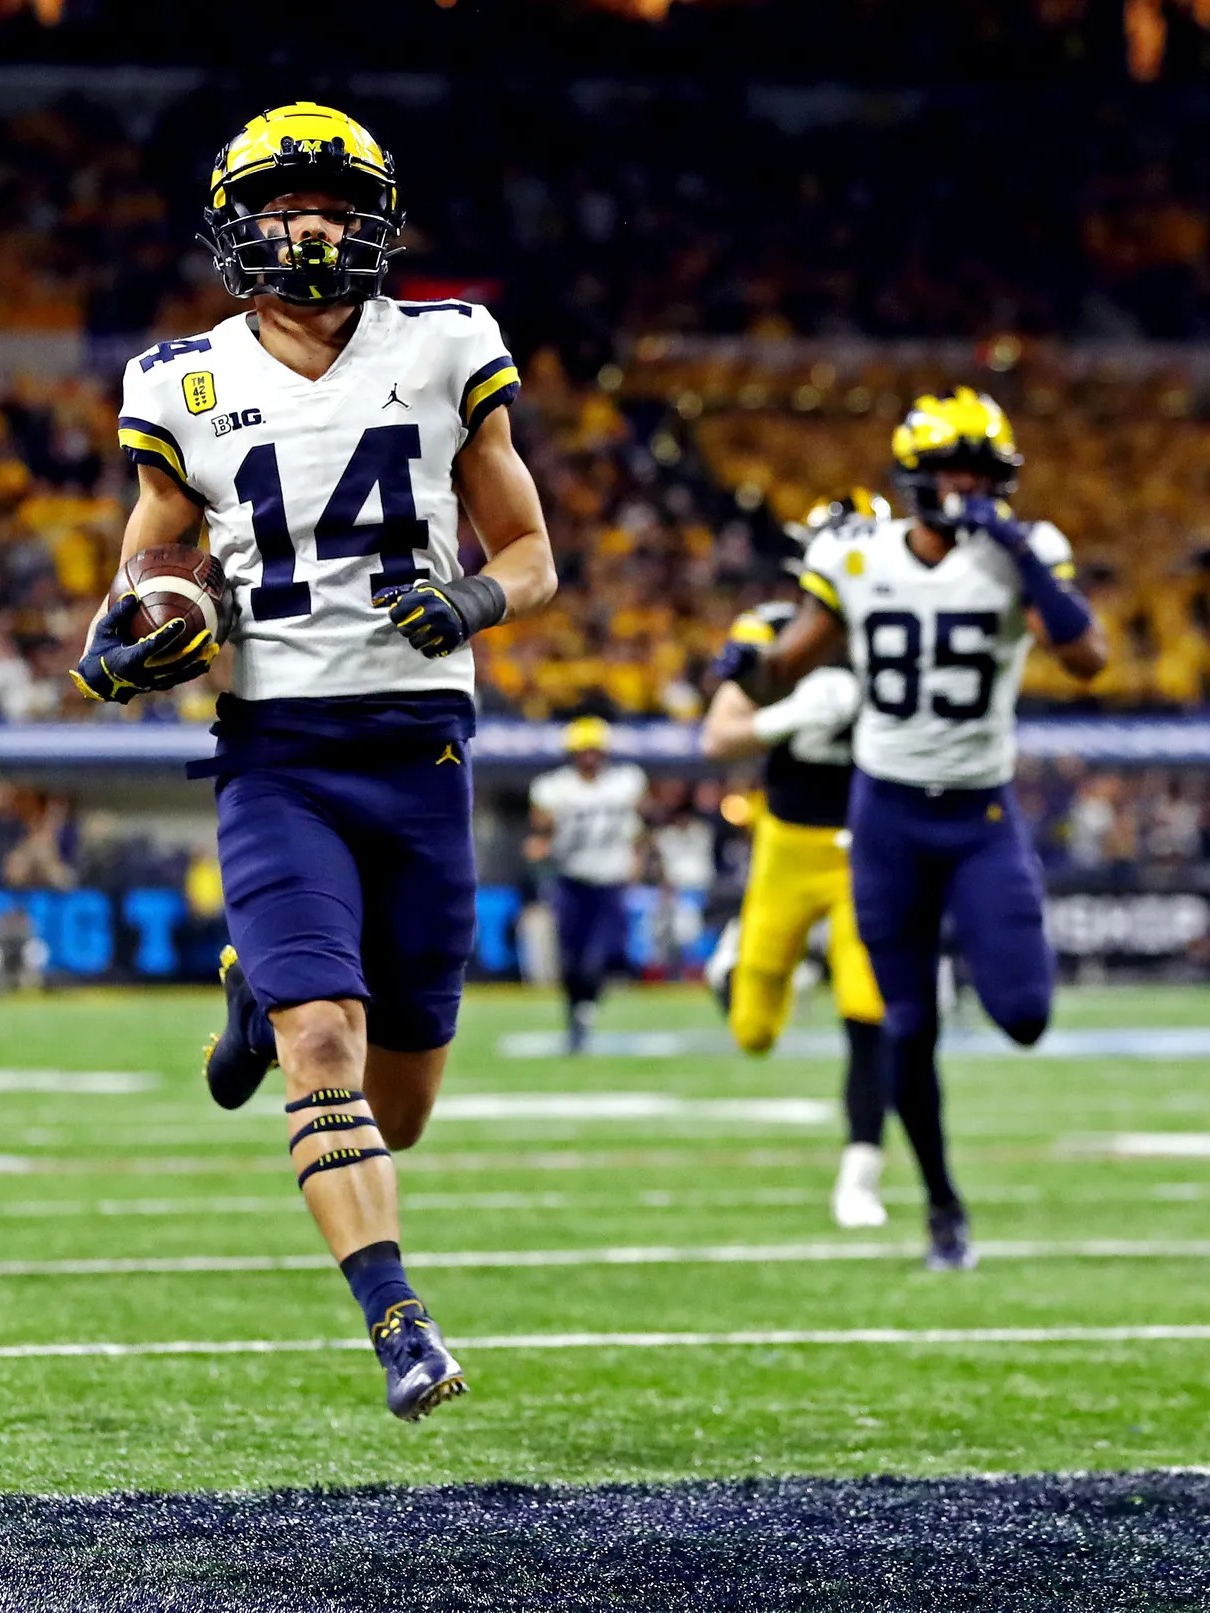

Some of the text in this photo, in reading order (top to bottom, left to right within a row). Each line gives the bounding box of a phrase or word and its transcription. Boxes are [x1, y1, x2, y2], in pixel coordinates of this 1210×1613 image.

[302, 140, 322, 153] M
[191, 376, 205, 387] TM
[193, 385, 206, 397] 42
[233, 423, 430, 621] 14
[863, 611, 1000, 720] 85
